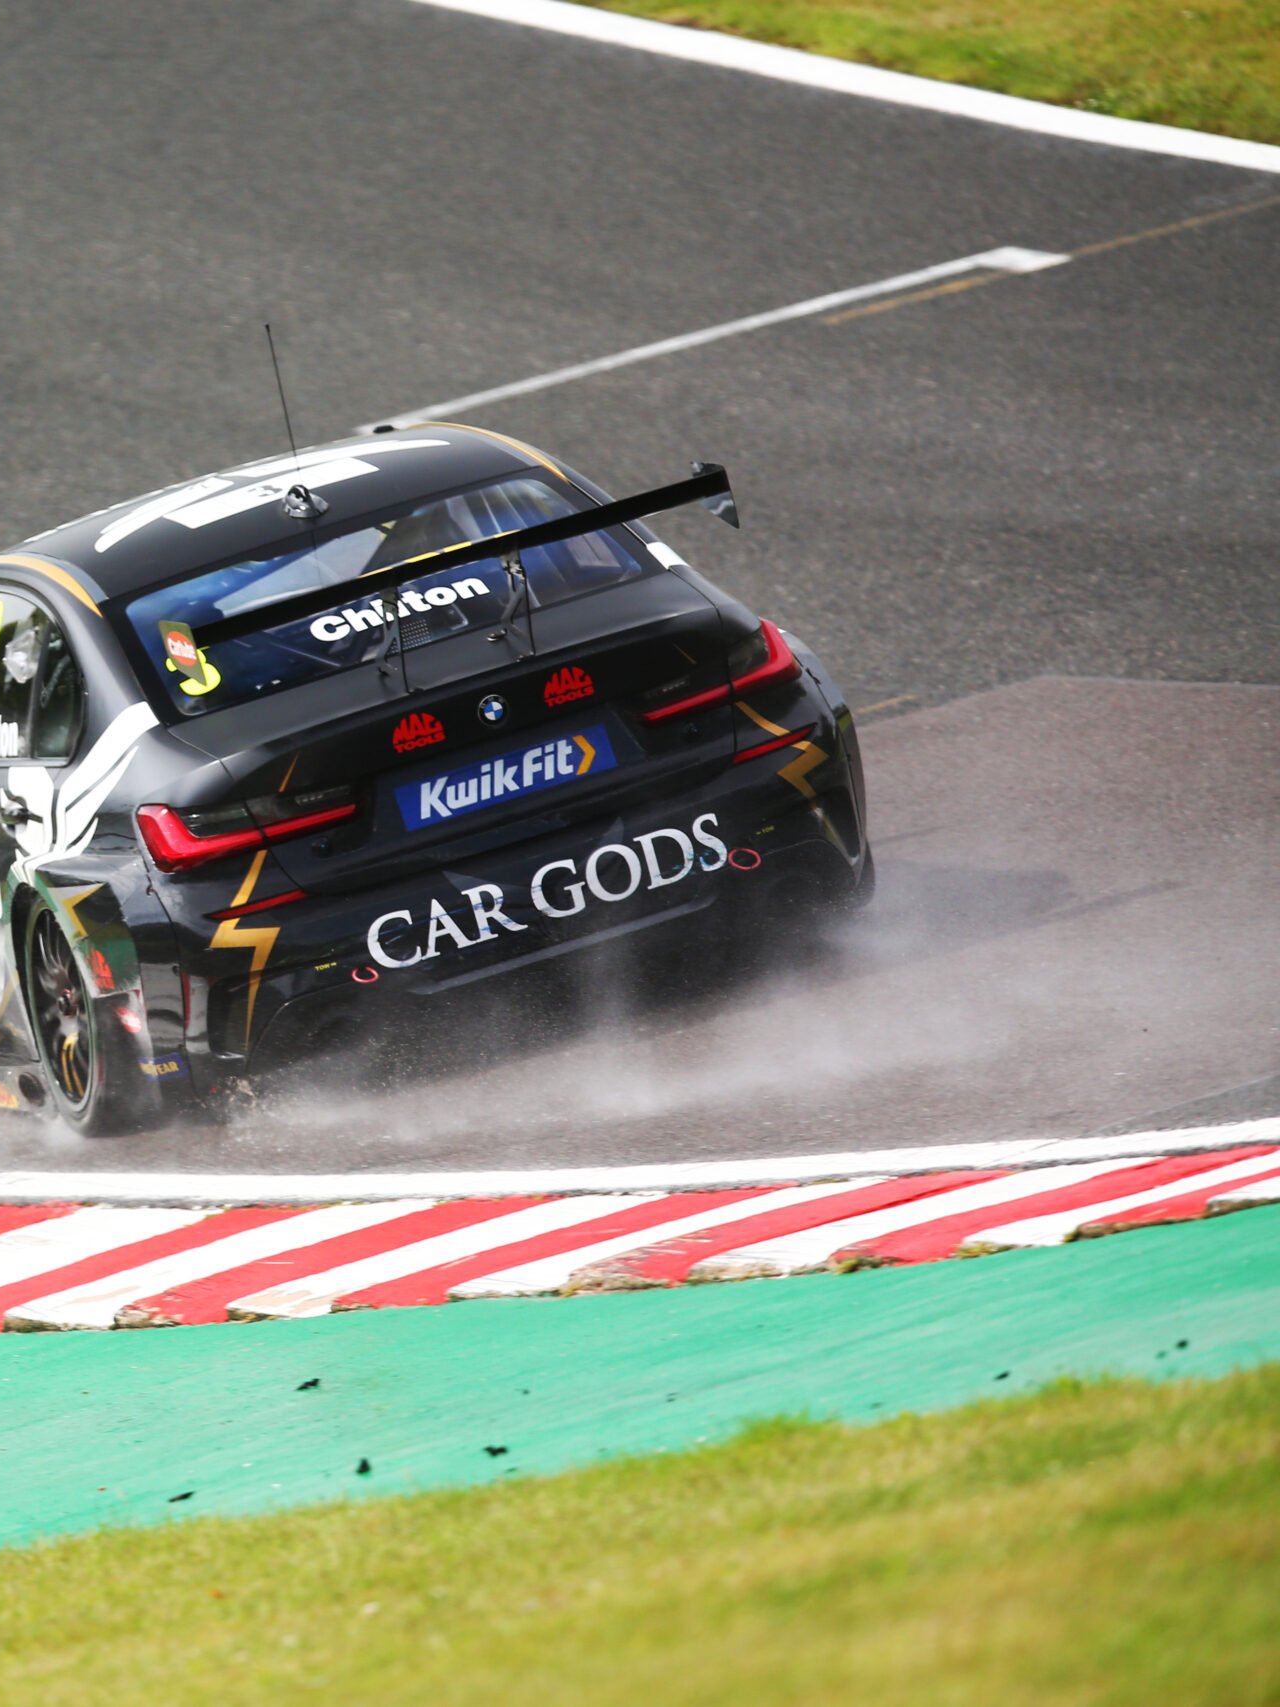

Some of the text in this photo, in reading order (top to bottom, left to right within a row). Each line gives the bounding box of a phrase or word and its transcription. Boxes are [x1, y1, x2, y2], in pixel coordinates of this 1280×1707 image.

[543, 666, 593, 699] MAC
[544, 686, 594, 708] TOOLS
[392, 712, 444, 745] MAC
[393, 731, 447, 753] TOOLS
[420, 739, 575, 820] Kwik Fit
[366, 813, 728, 969] CAR GODS
